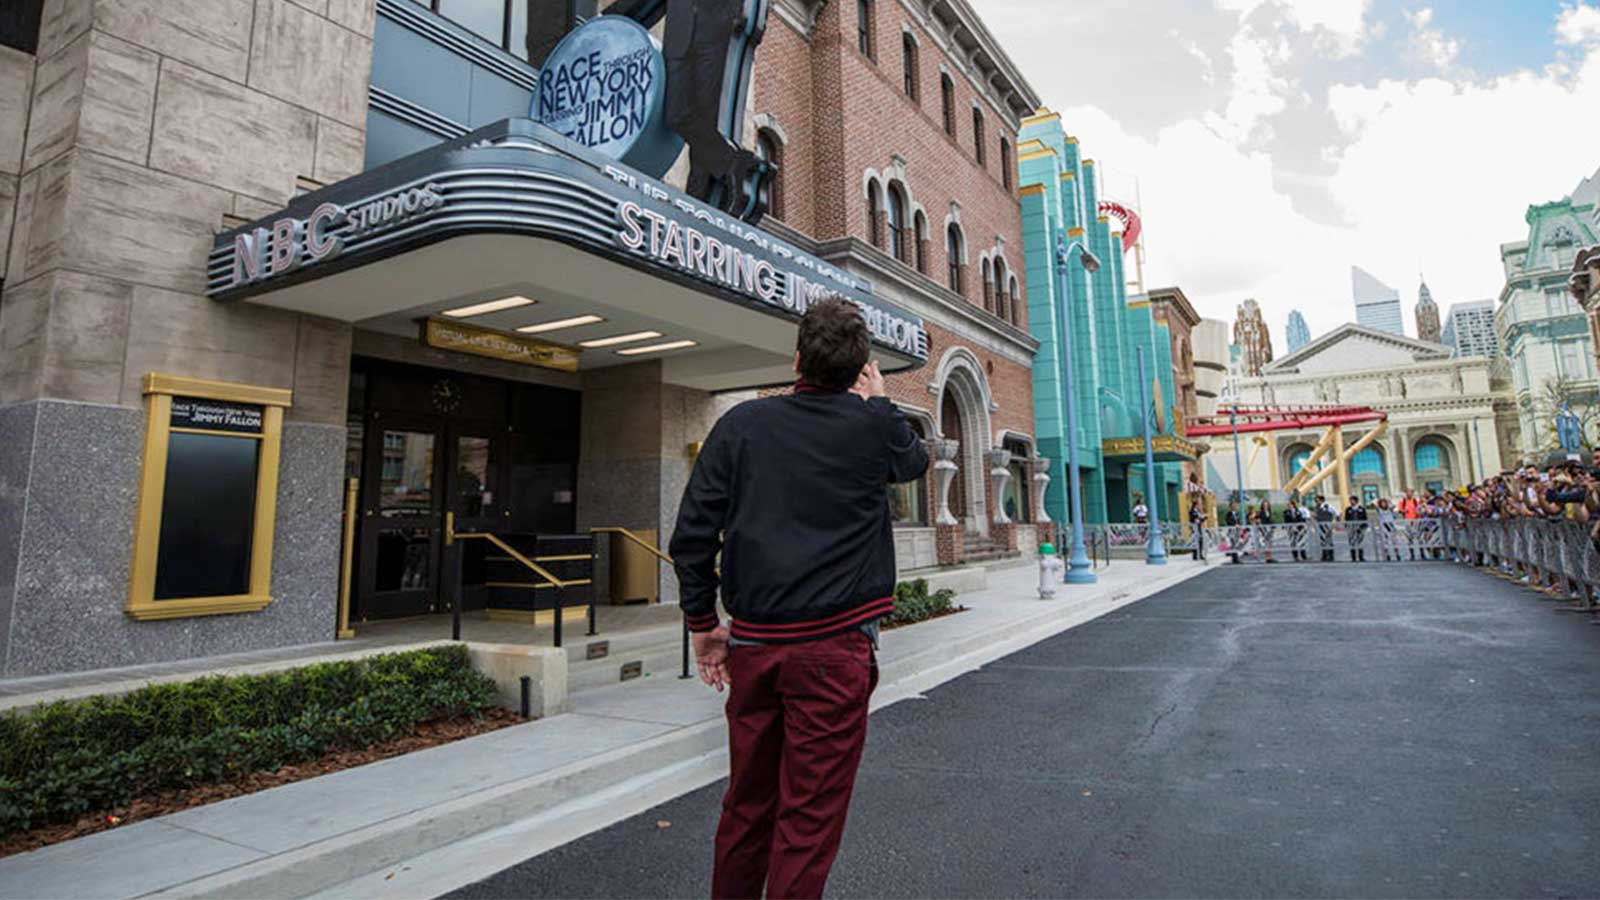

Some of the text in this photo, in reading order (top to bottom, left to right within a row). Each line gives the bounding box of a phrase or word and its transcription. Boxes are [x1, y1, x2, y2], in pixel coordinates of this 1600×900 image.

[539, 55, 652, 117] NEW YORK
[540, 47, 650, 91] RACE THROUGH
[578, 80, 652, 127] JIMMY
[232, 182, 441, 285] NBC STUDIOS
[618, 201, 777, 301] STARRING
[782, 271, 849, 316] JIM
[225, 413, 262, 427] FALLON
